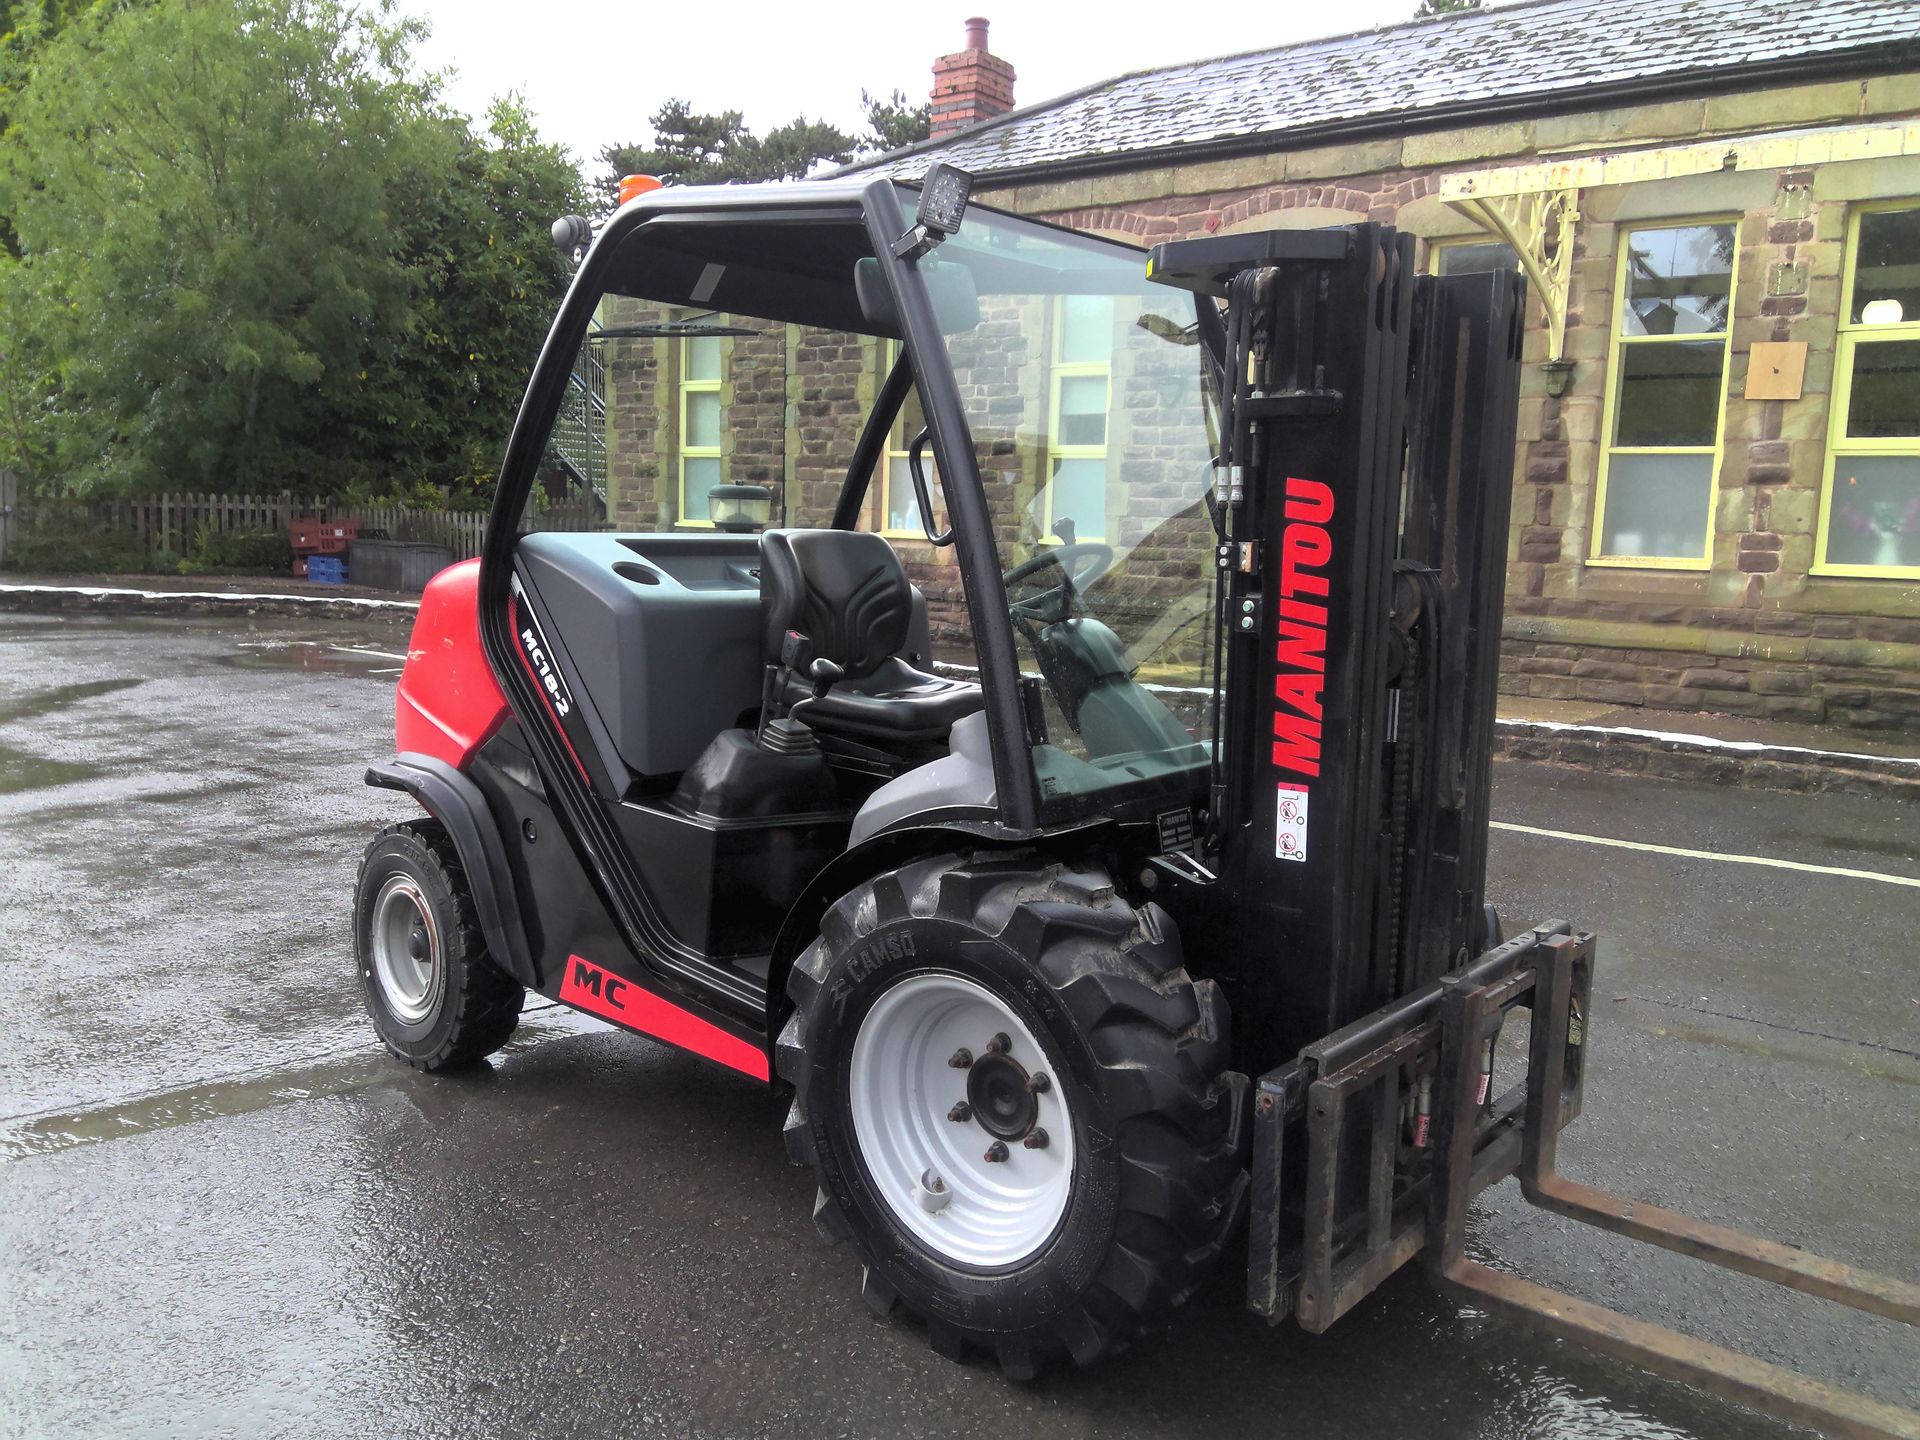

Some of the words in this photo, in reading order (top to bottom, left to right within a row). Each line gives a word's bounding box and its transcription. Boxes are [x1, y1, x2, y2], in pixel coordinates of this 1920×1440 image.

[1273, 477, 1335, 777] MANITOU
[521, 628, 570, 717] MC18-2
[574, 960, 627, 1011] MC
[846, 929, 917, 983] CAMSO
